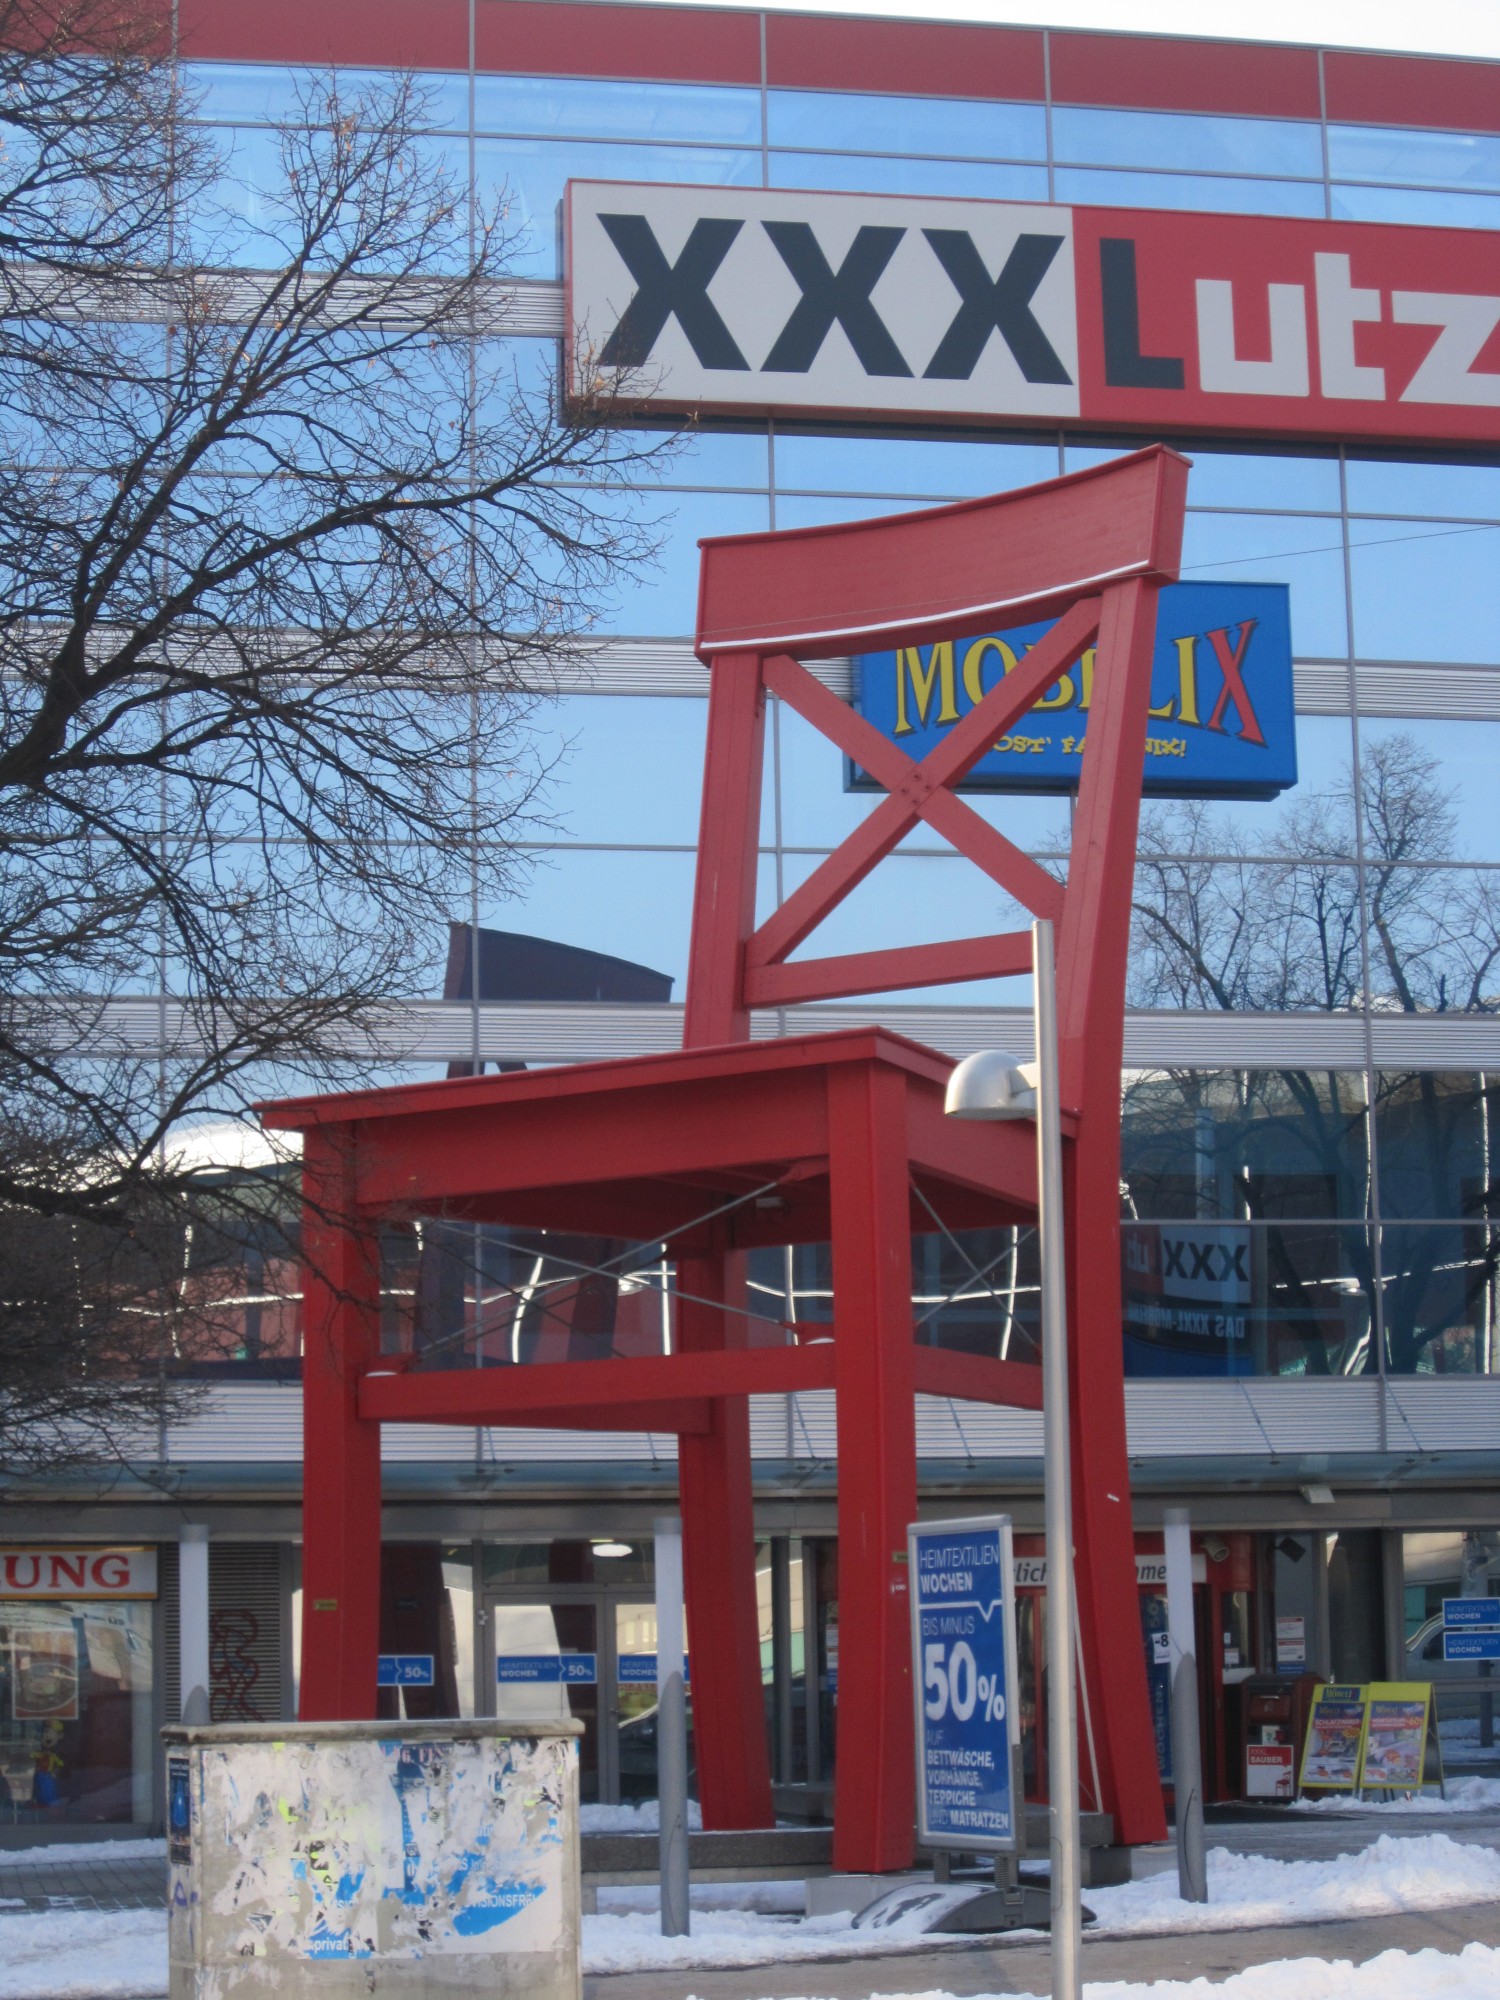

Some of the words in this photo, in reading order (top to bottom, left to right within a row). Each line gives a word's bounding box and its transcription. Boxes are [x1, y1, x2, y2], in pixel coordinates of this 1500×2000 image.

[596, 213, 1500, 405] XXXLutz
[919, 1544, 1000, 1569] HEIMTEXTILIEN
[0, 1555, 130, 1588] UNG
[920, 1571, 973, 1593] WOCHEN
[922, 1617, 938, 1636] BIS
[940, 1615, 976, 1635] MINUS
[1447, 1612, 1481, 1620] WOCHEN
[1448, 1646, 1482, 1654] WOCHEN
[404, 1666, 430, 1678] 50%
[500, 1669, 538, 1677] WOCHEN
[568, 1665, 593, 1677] 50%
[925, 1641, 1006, 1722] 50%
[927, 1730, 944, 1745] AUF
[927, 1747, 995, 1770] BETTWÄSCHE,
[1250, 1756, 1283, 1764] SAUBER
[927, 1767, 983, 1788] VORHÄNGE,
[928, 1790, 976, 1806] TEPPICHE
[950, 1810, 1009, 1829] MATRATZEN
